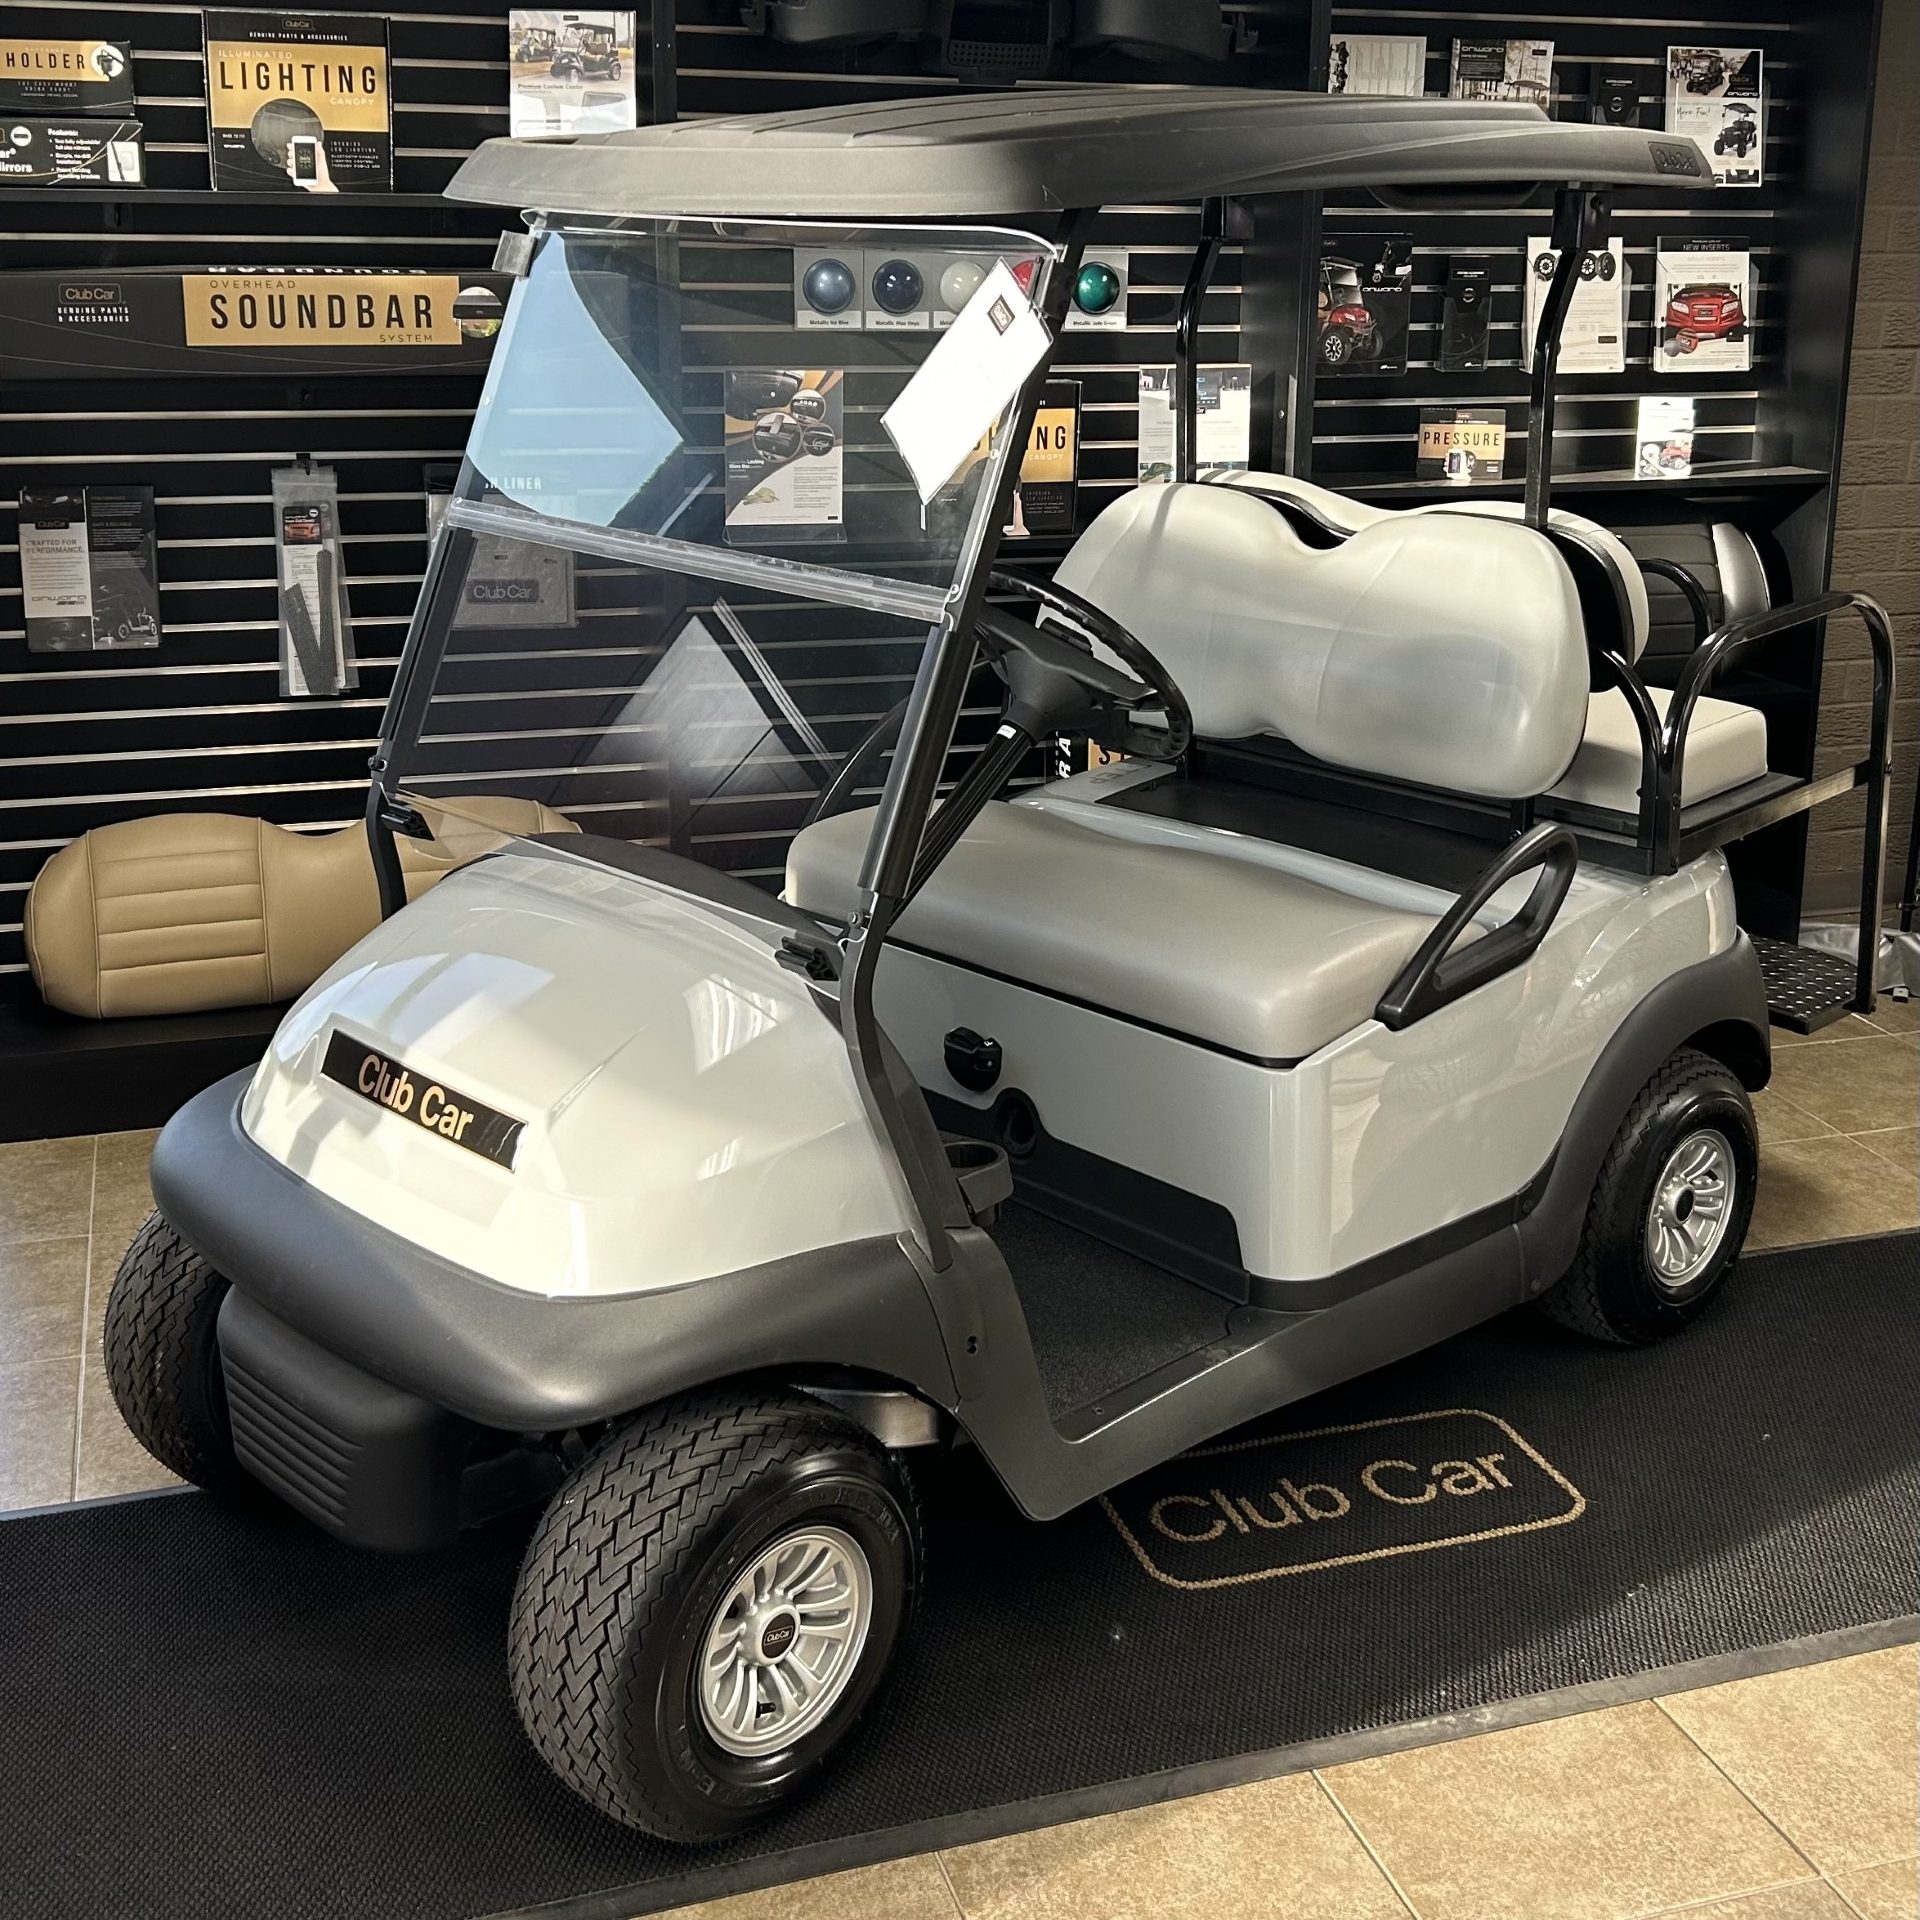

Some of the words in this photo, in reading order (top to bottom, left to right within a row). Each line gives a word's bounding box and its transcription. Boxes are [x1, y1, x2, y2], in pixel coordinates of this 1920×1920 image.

[6, 52, 86, 69] HOLDER
[218, 50, 293, 59] ILLUMINATED
[220, 61, 376, 94] LIGHTING
[330, 97, 374, 106] CANOPY
[0, 163, 33, 173] irrors
[210, 280, 296, 289] OVERHEAD
[65, 288, 93, 300] Club
[93, 288, 115, 300] Car
[210, 294, 433, 329] SOUNDBAR
[379, 334, 433, 343] SYSTEM
[1423, 431, 1501, 446] PRESSURE
[504, 477, 542, 490] LINER
[473, 585, 506, 598] Club
[507, 585, 533, 598] Car
[358, 1054, 414, 1113] Club
[419, 1085, 474, 1140] Car
[1150, 1477, 1350, 1544] Club
[1361, 1453, 1513, 1505] Car
